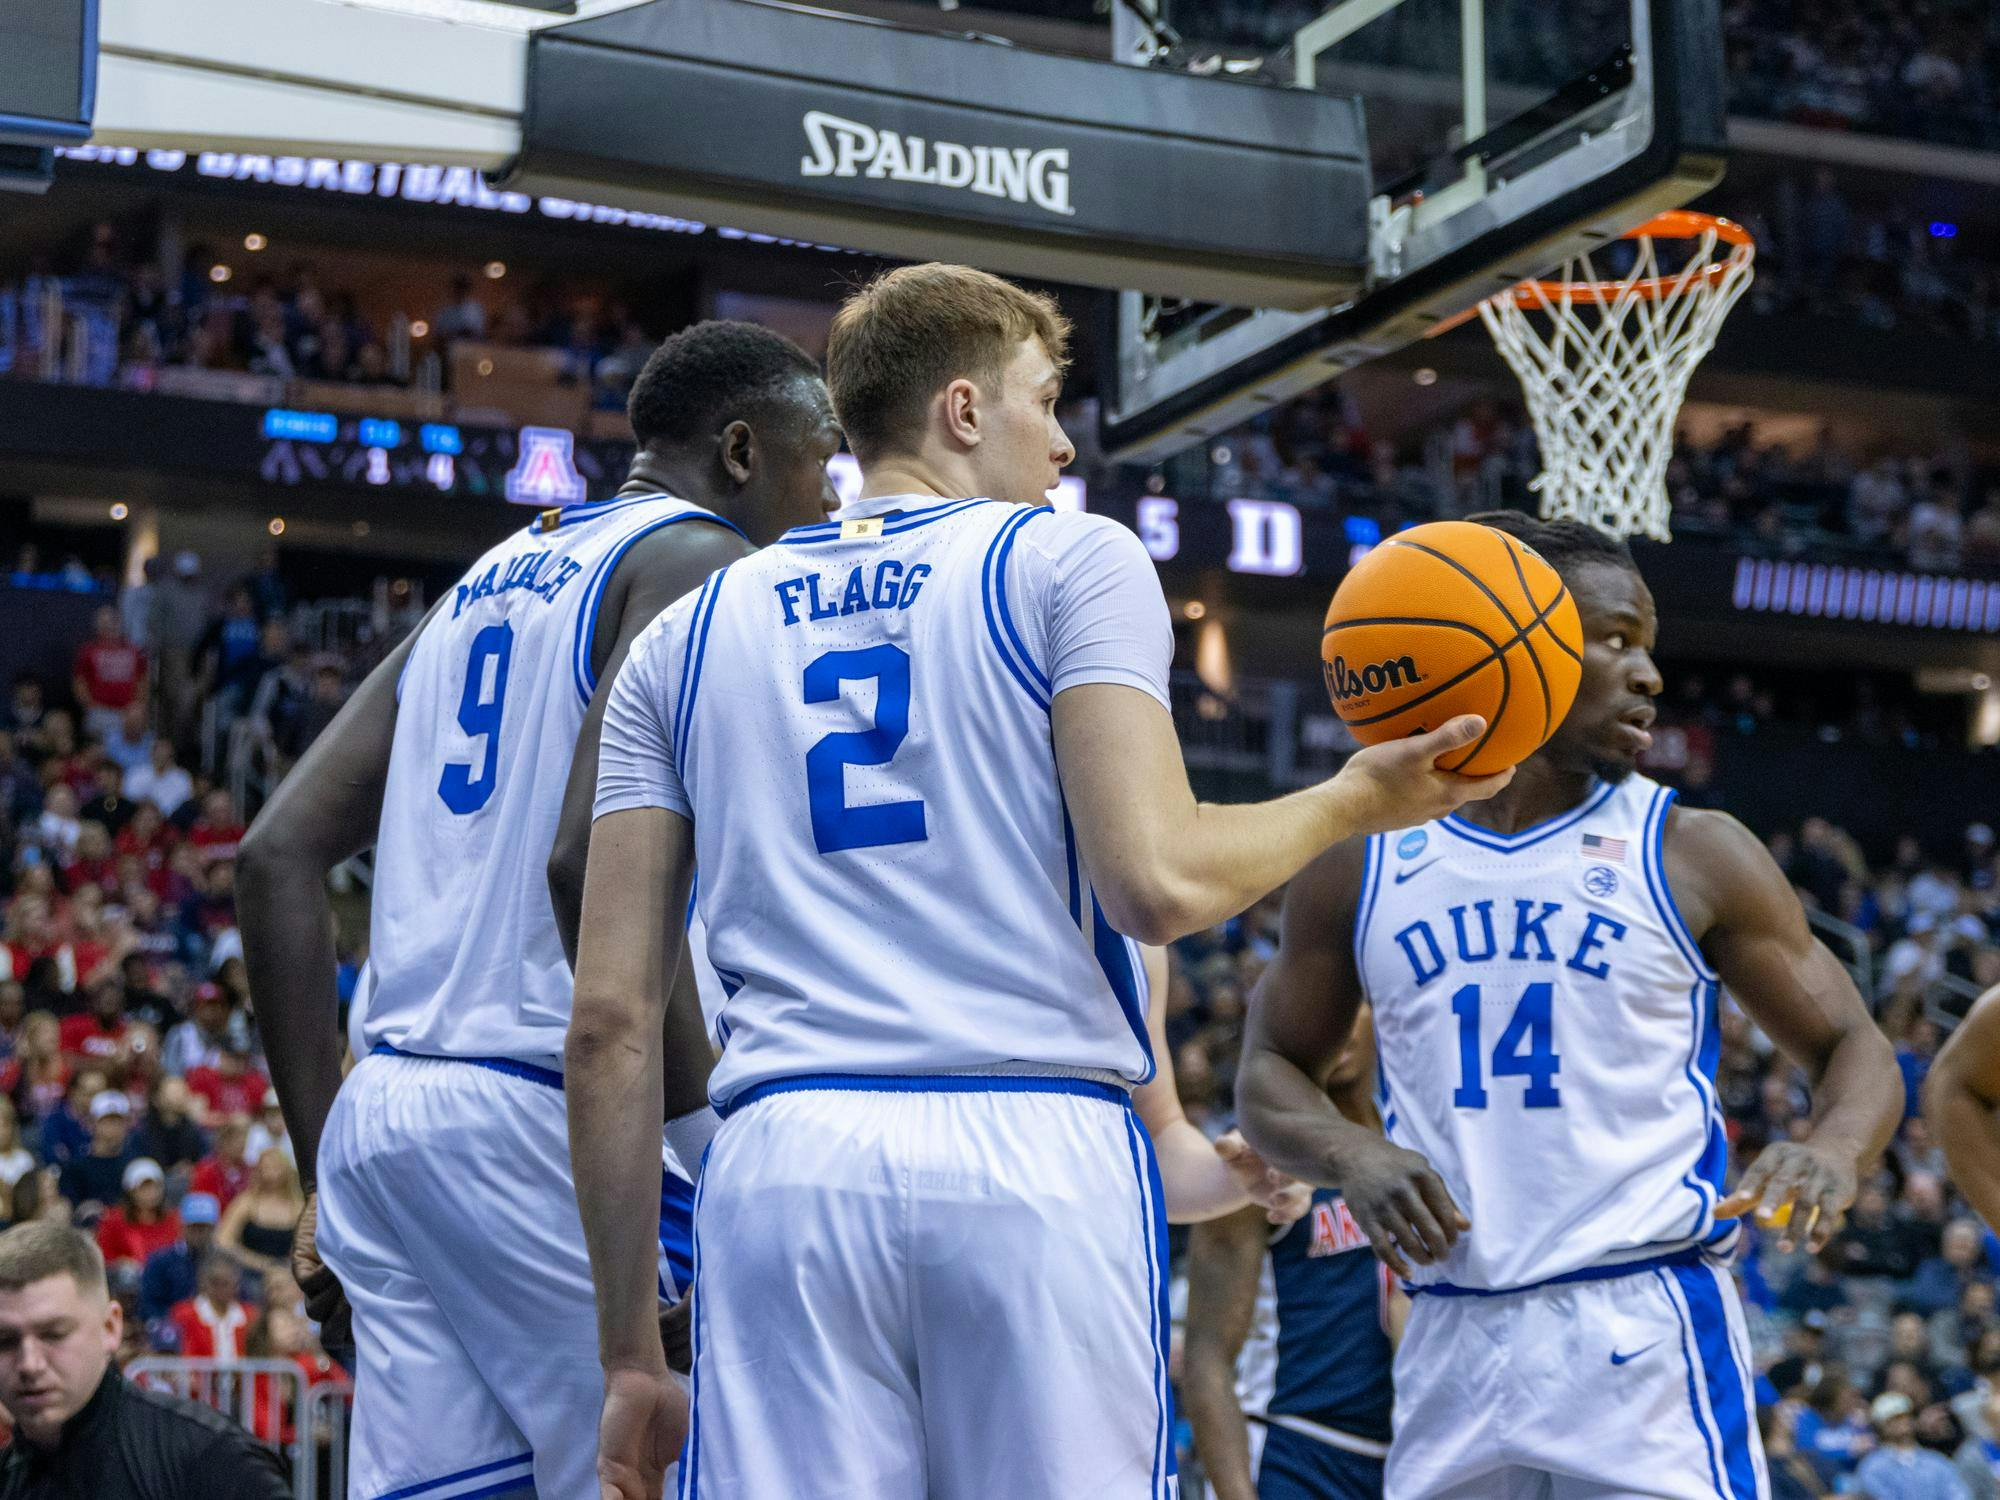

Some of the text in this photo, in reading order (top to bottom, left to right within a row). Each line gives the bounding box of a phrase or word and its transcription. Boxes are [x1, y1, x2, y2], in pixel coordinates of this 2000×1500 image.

[801, 110, 1076, 216] SPALDING
[1136, 496, 1180, 561] 5
[1227, 498, 1303, 577] D
[774, 559, 932, 627] FLAGG
[437, 618, 514, 816] 9
[1321, 655, 1424, 701] ilson
[803, 642, 928, 855] 2
[1394, 899, 1628, 988] DUKE
[1451, 982, 1562, 1110] 14
